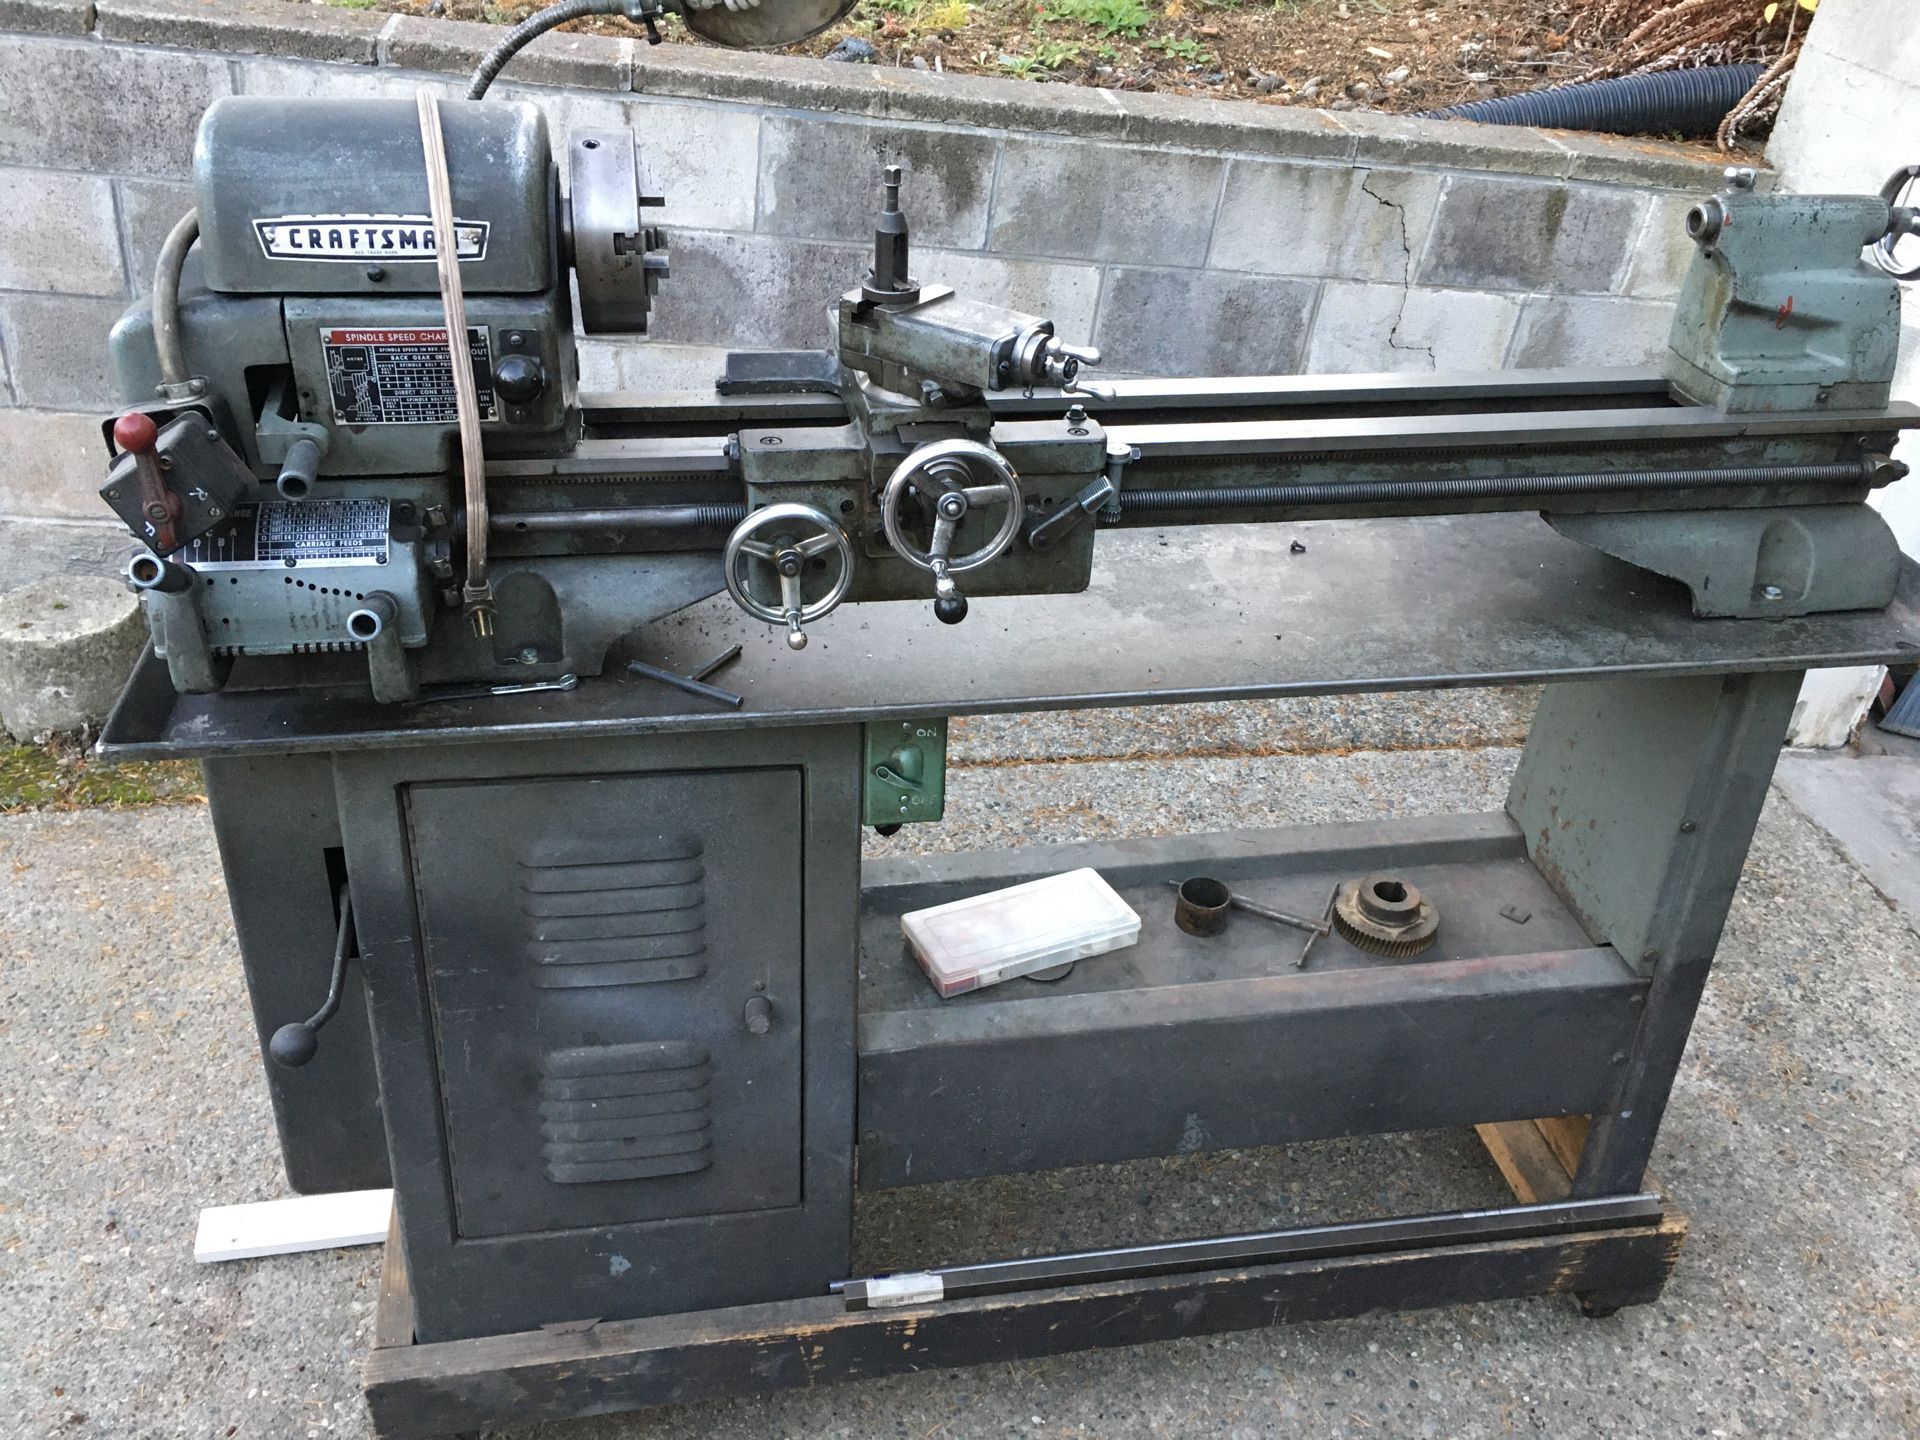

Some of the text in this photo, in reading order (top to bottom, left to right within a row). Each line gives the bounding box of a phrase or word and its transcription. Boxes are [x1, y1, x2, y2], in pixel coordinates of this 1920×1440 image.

[288, 228, 459, 250] CRAFTSMA
[346, 332, 448, 342] SPINDLE SPEED CHAR
[229, 528, 237, 537] A
[193, 538, 225, 548] D B
[916, 727, 937, 737] ON
